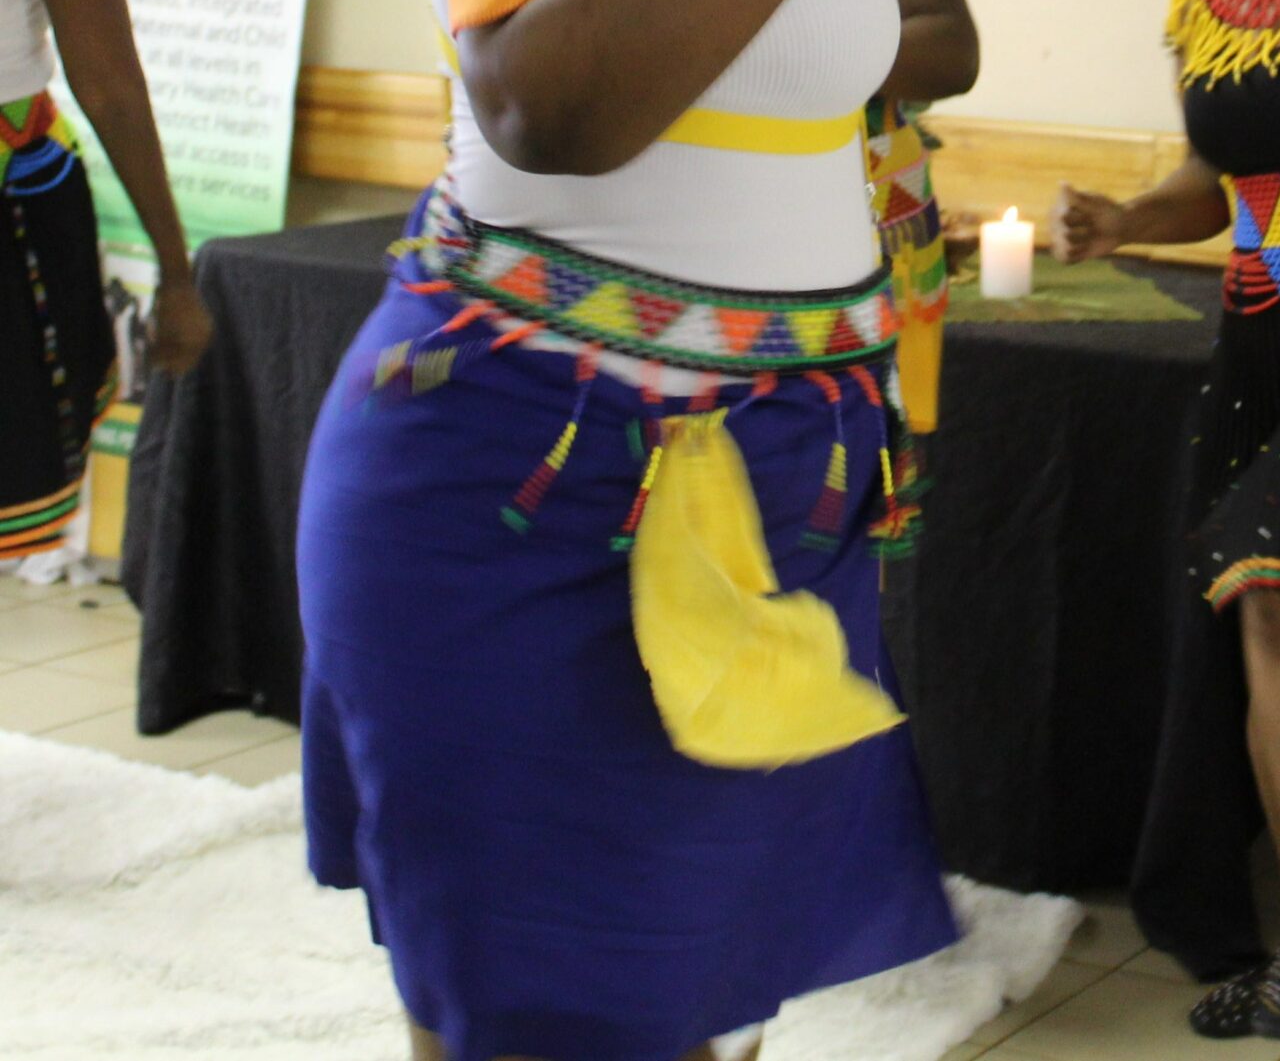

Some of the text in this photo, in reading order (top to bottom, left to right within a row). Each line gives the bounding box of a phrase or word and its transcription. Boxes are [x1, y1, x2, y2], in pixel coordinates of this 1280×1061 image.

[206, 22, 242, 44] and
[190, 52, 239, 75] levels
[191, 146, 249, 169] access
[201, 175, 271, 203] services
